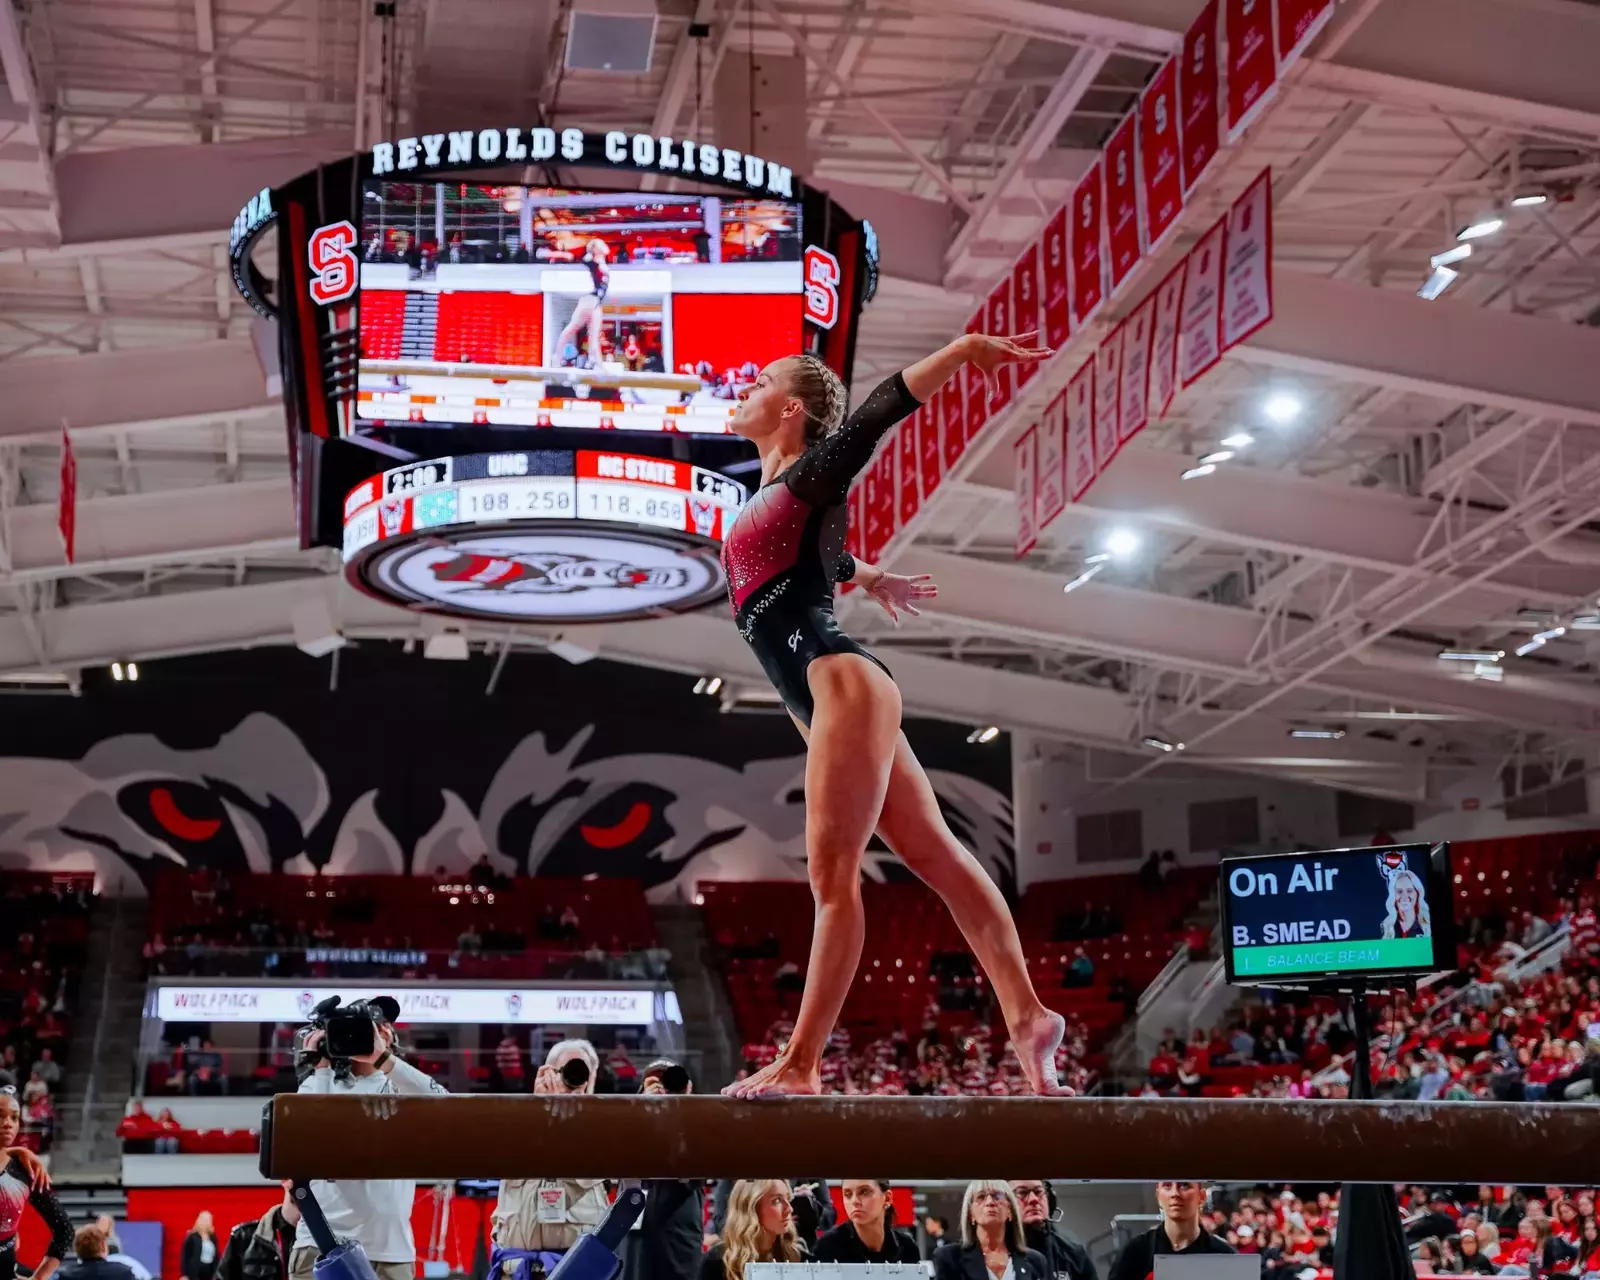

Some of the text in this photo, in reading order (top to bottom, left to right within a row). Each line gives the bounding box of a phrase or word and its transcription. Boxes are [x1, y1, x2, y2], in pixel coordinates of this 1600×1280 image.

[372, 128, 793, 198] REYNOLDS COLISEUM
[597, 454, 677, 485] NC STATE
[470, 491, 569, 513] 108.250
[590, 493, 682, 520] 118.050
[1229, 862, 1339, 897] On Air
[1232, 919, 1351, 946] B. SMEAD
[1267, 951, 1333, 968] BALANCE
[1338, 948, 1380, 964] BEAM
[174, 992, 260, 1008] WOLFPACK
